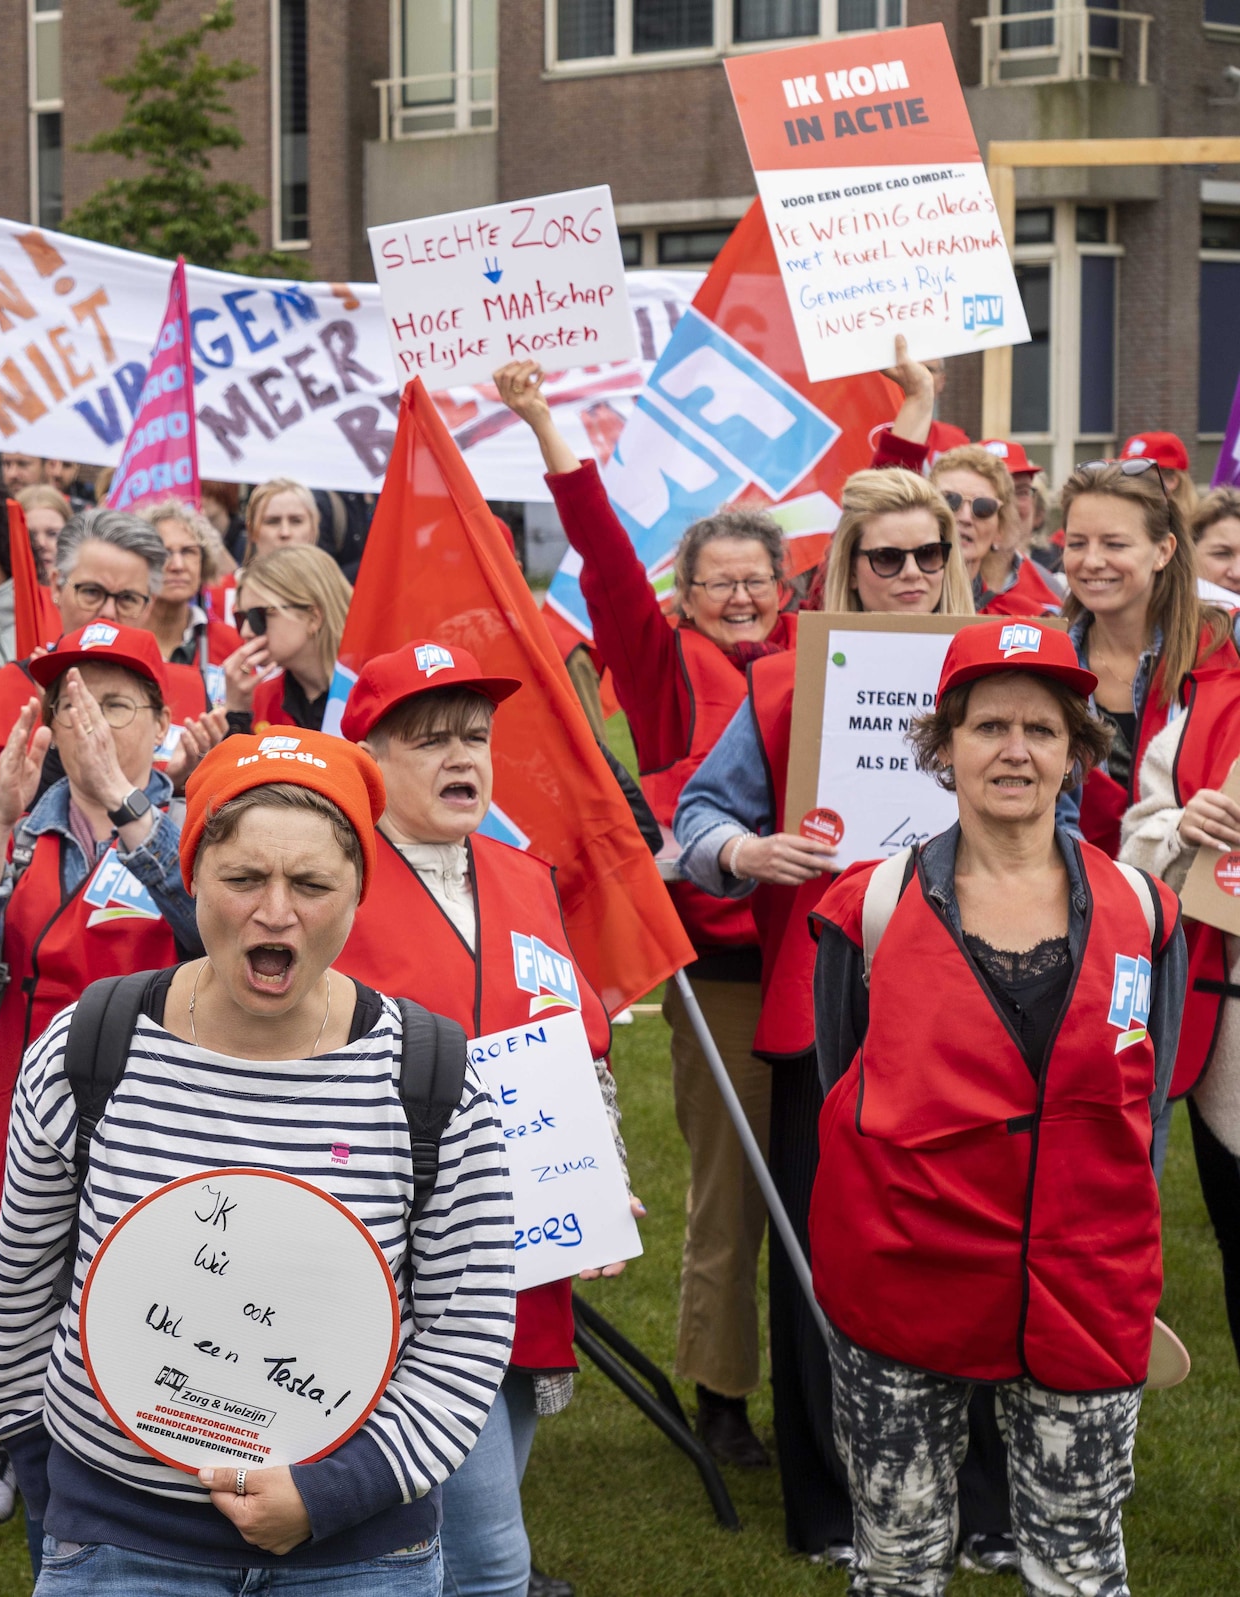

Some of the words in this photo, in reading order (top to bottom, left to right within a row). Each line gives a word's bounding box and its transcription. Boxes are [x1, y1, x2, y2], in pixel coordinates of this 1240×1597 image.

[781, 76, 823, 108] IK
[825, 60, 910, 101] KOM
[784, 115, 825, 147] IN
[834, 97, 929, 138] ACTIE
[781, 194, 815, 209] VOOR
[817, 190, 841, 203] EEN
[843, 181, 883, 198] GOEDE
[885, 177, 909, 191] CAO
[511, 207, 602, 248] ZORG
[392, 308, 464, 341] HOGE
[964, 295, 1003, 328] FNV
[198, 320, 382, 464] MEER
[81, 625, 118, 645] FNV
[1002, 627, 1040, 646] FNV
[417, 647, 453, 667] FNV
[856, 690, 917, 707] STEGEN
[849, 715, 892, 731] MAAR
[260, 736, 300, 751] FNV
[237, 755, 259, 768] in
[265, 751, 327, 769] actie
[856, 755, 884, 770] ALS
[889, 757, 909, 771] DE
[516, 943, 574, 993] FNV
[1115, 970, 1151, 1014] FN
[193, 1340, 239, 1364] een
[156, 1369, 189, 1388] FNV
[155, 1404, 260, 1440] #OUDERENZORGINACTIE
[181, 1390, 210, 1407] Zorg
[211, 1399, 221, 1409] &
[224, 1402, 267, 1422] Welzijn
[136, 1410, 272, 1455] #GEHANDICAPTENZORGINACTIE
[136, 1421, 265, 1464] #NEDERLANDVERDIENTBETER
